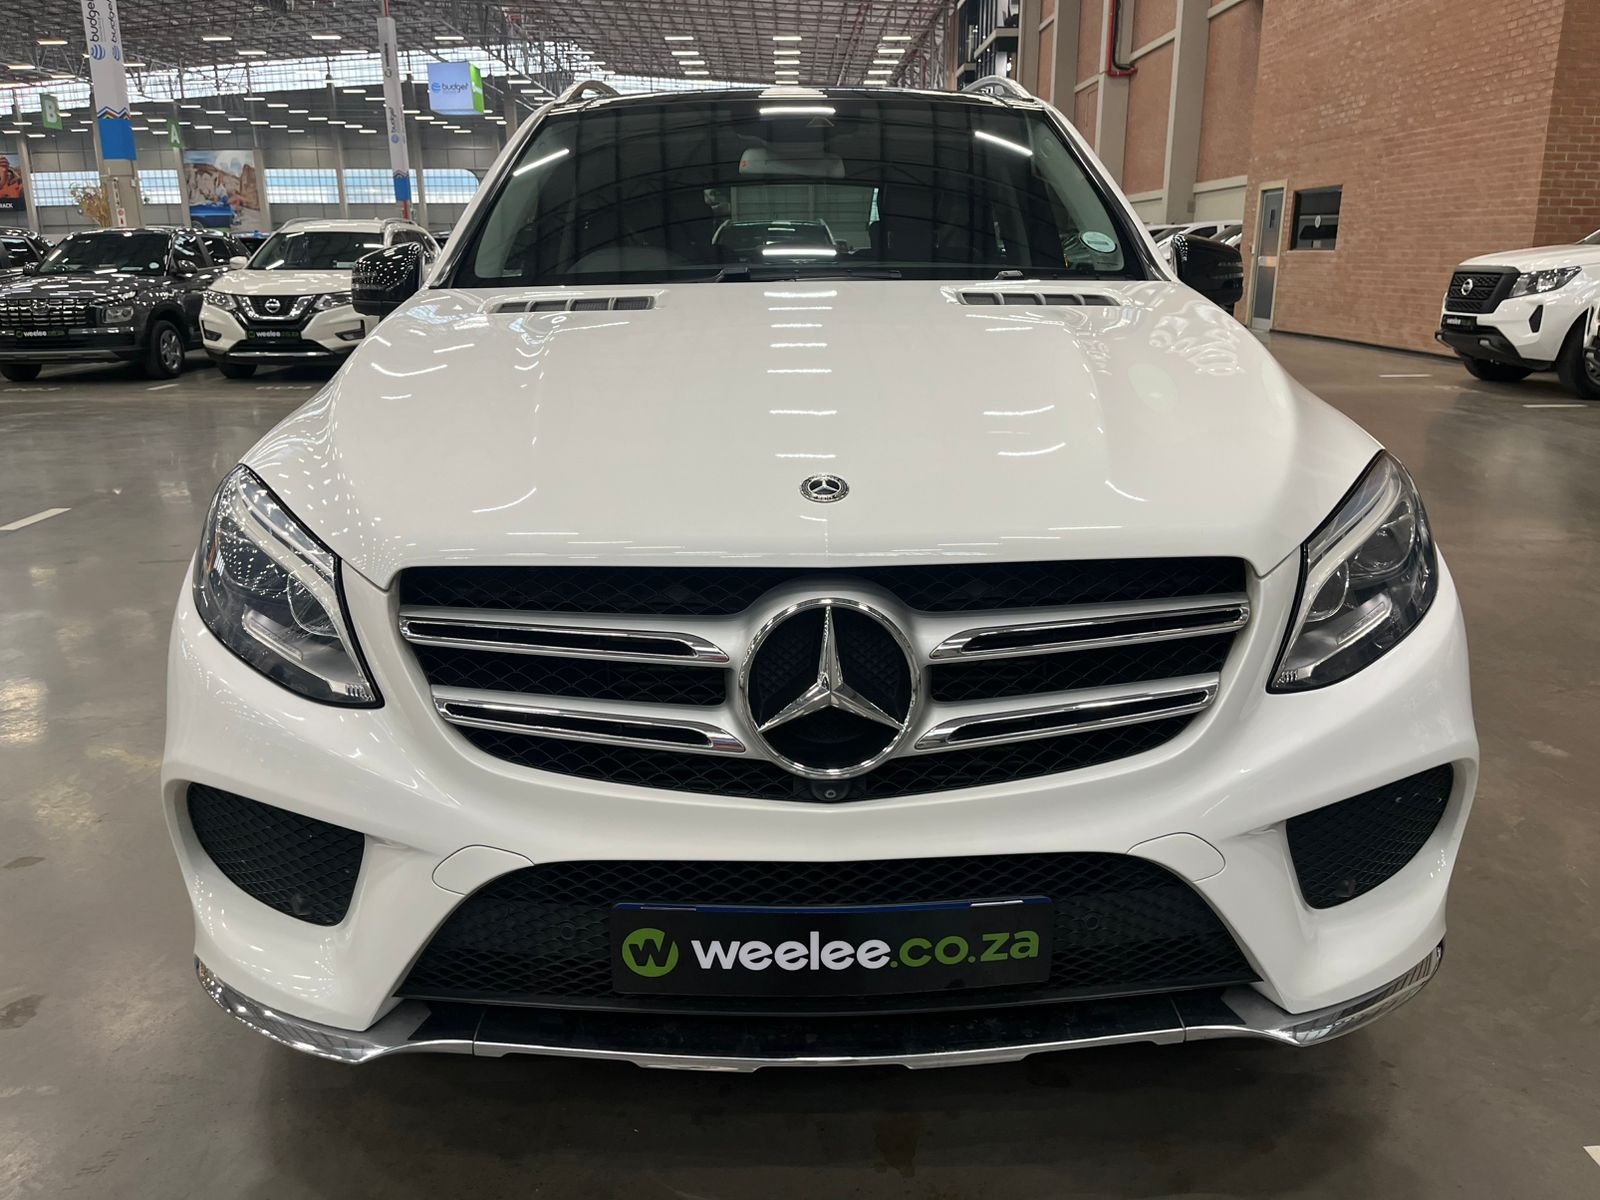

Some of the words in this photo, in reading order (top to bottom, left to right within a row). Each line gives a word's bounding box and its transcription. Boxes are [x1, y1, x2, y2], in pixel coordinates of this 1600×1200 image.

[86, 0, 100, 42] budge
[107, 0, 117, 43] budge
[441, 82, 469, 94] budget
[45, 100, 58, 123] B
[171, 124, 180, 144] A
[691, 930, 1040, 971] weelee.co.za
